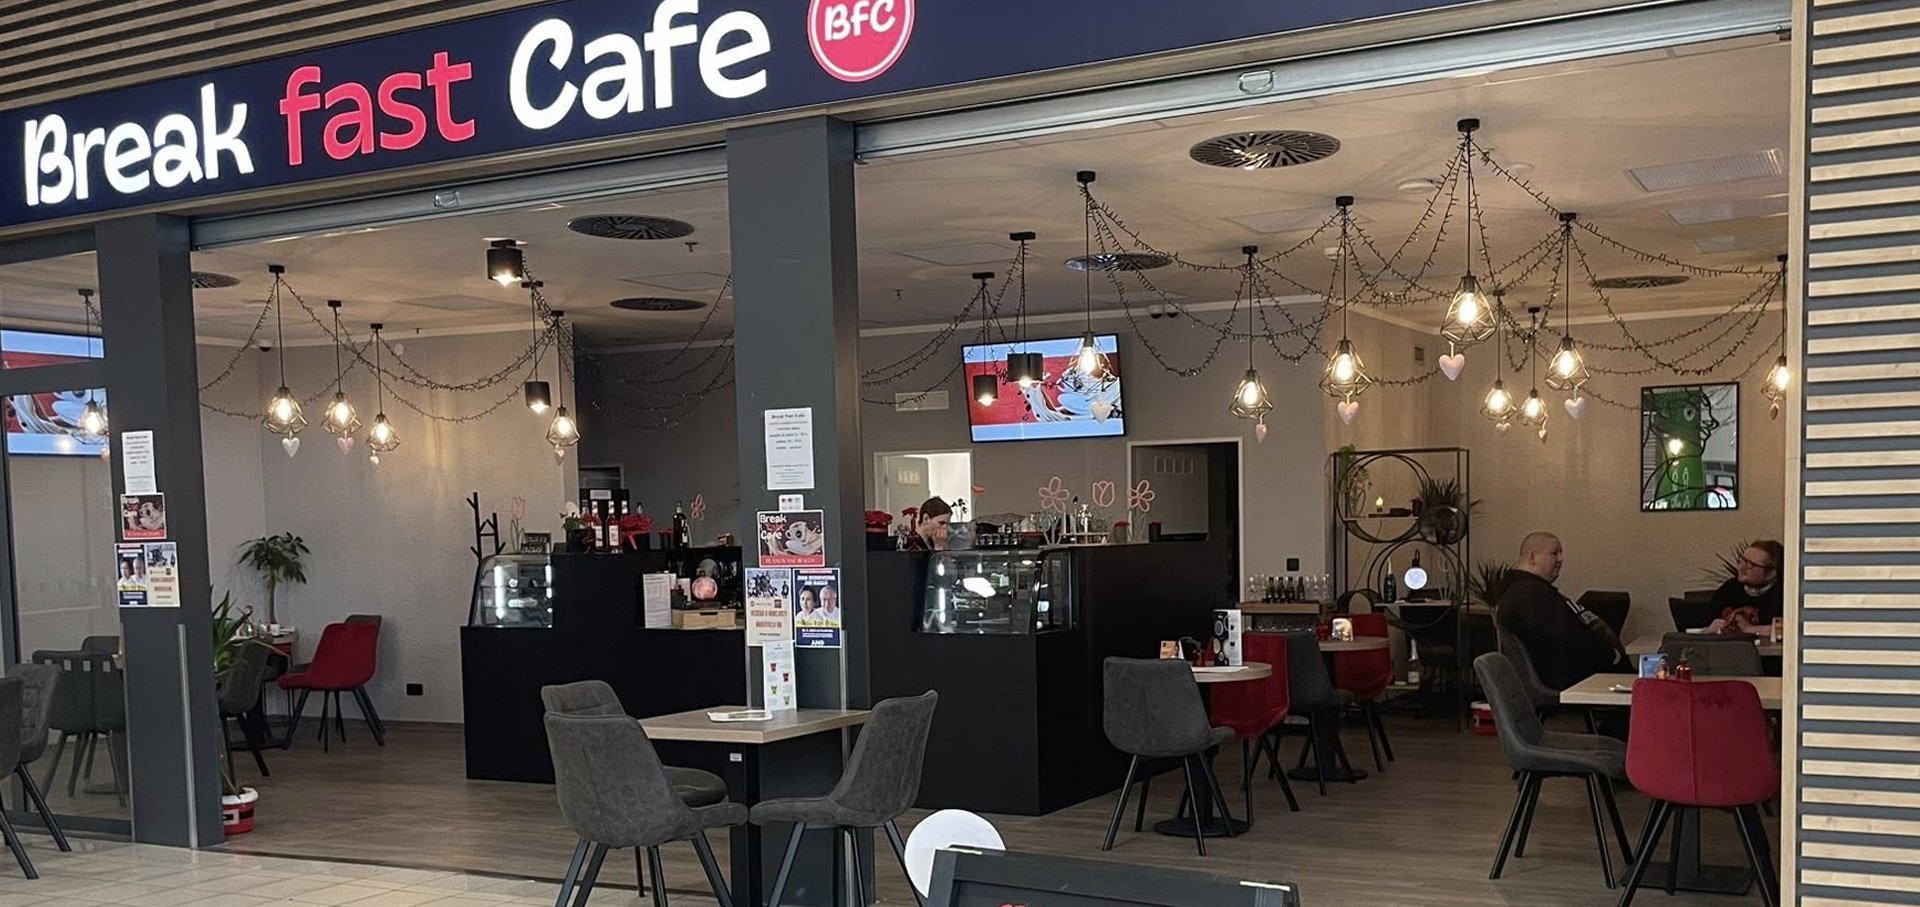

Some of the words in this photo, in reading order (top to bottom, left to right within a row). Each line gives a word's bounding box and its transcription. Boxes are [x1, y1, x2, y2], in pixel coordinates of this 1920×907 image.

[24, 82, 255, 206] Break
[279, 51, 476, 166] fast
[509, 0, 772, 130] Cafe
[760, 514, 787, 524] Break
[760, 530, 783, 541] Cafe
